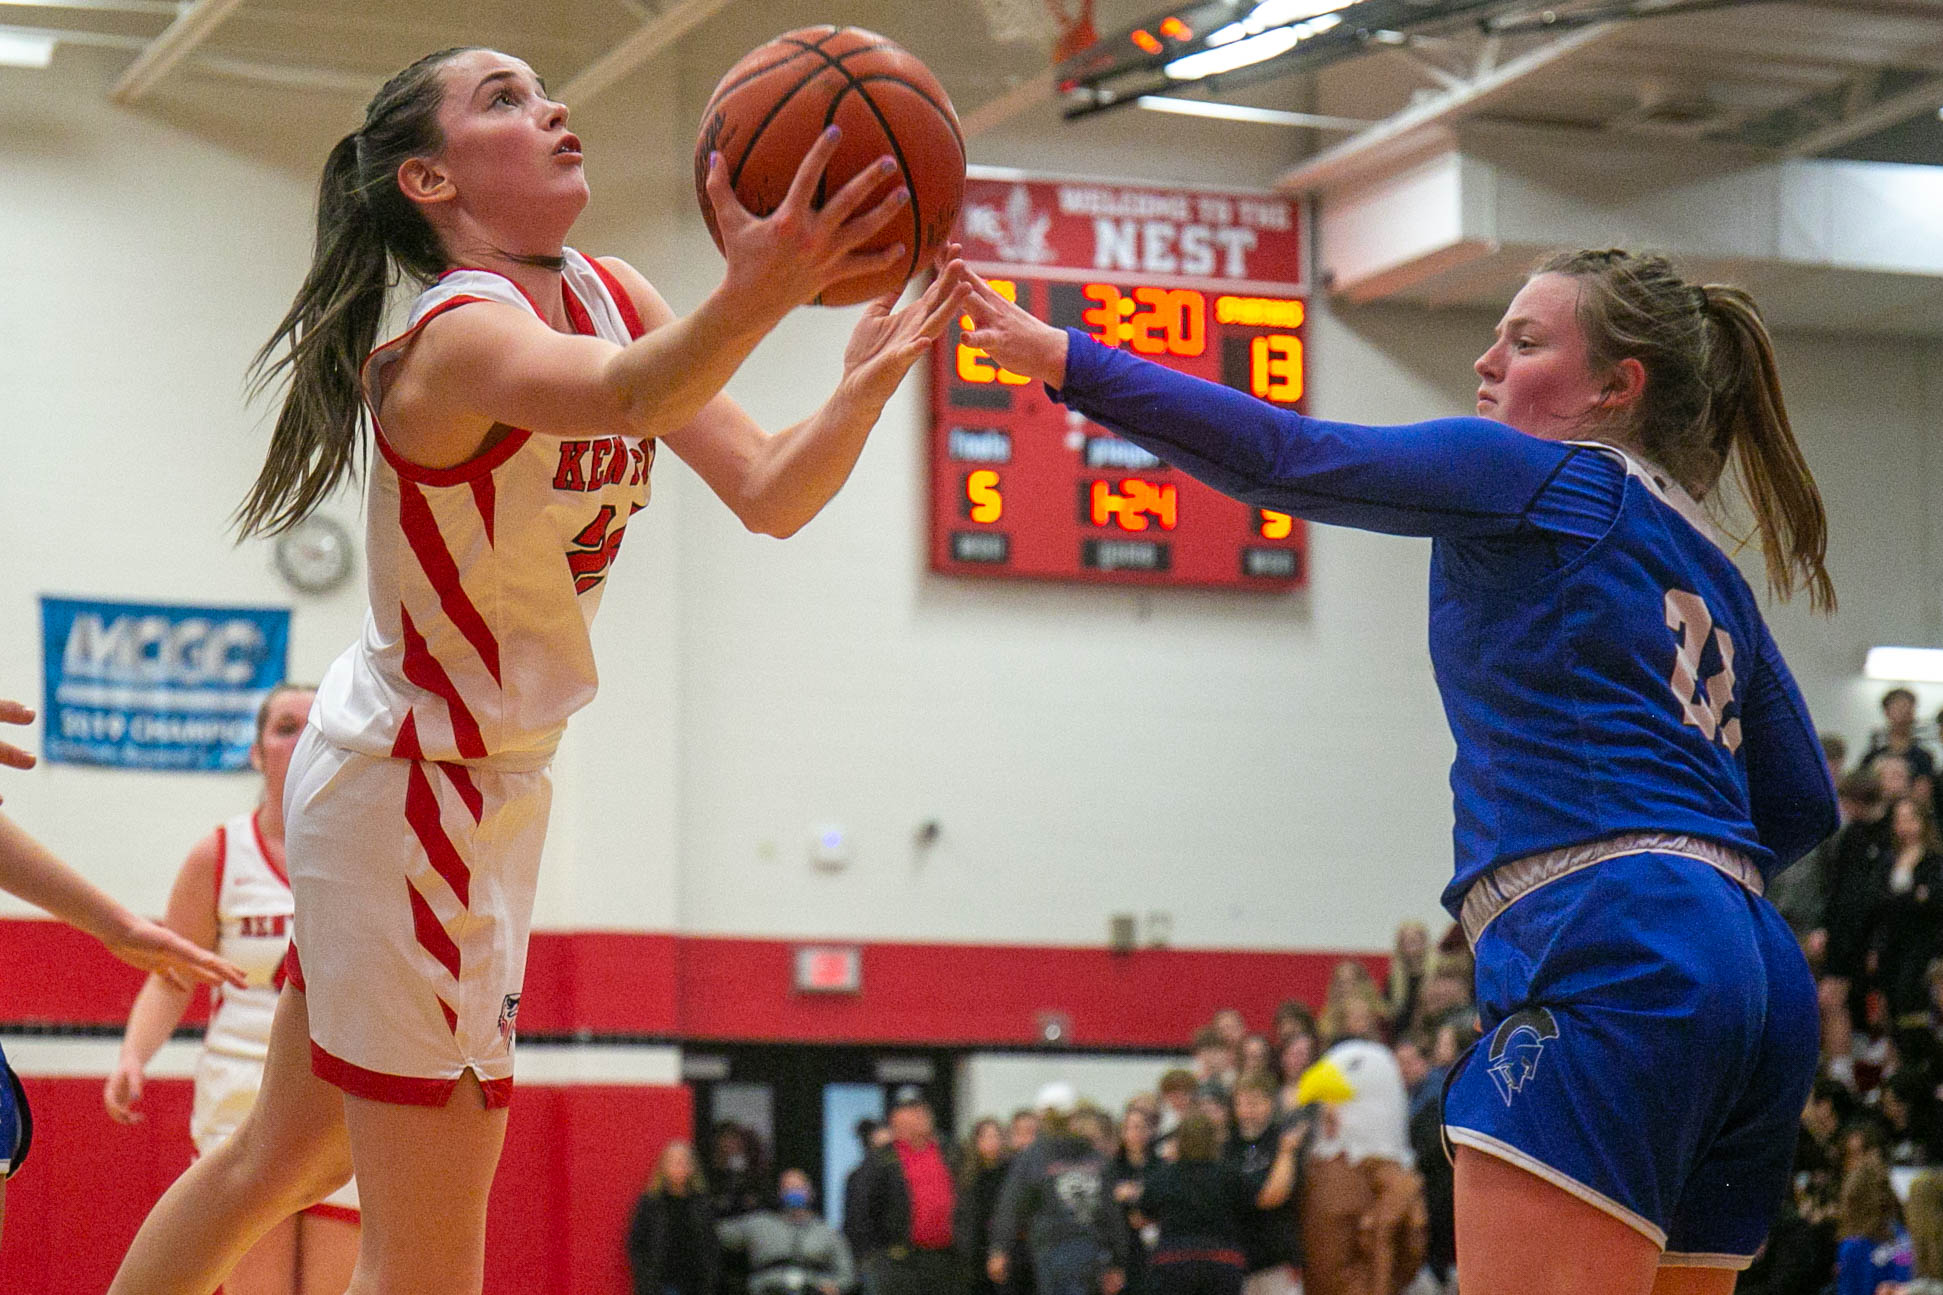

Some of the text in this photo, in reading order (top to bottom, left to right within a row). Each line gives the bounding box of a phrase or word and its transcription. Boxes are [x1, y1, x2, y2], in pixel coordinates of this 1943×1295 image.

[1094, 219, 1258, 278] NEST
[1082, 283, 1206, 357] 3:20
[1250, 334, 1304, 402] 13
